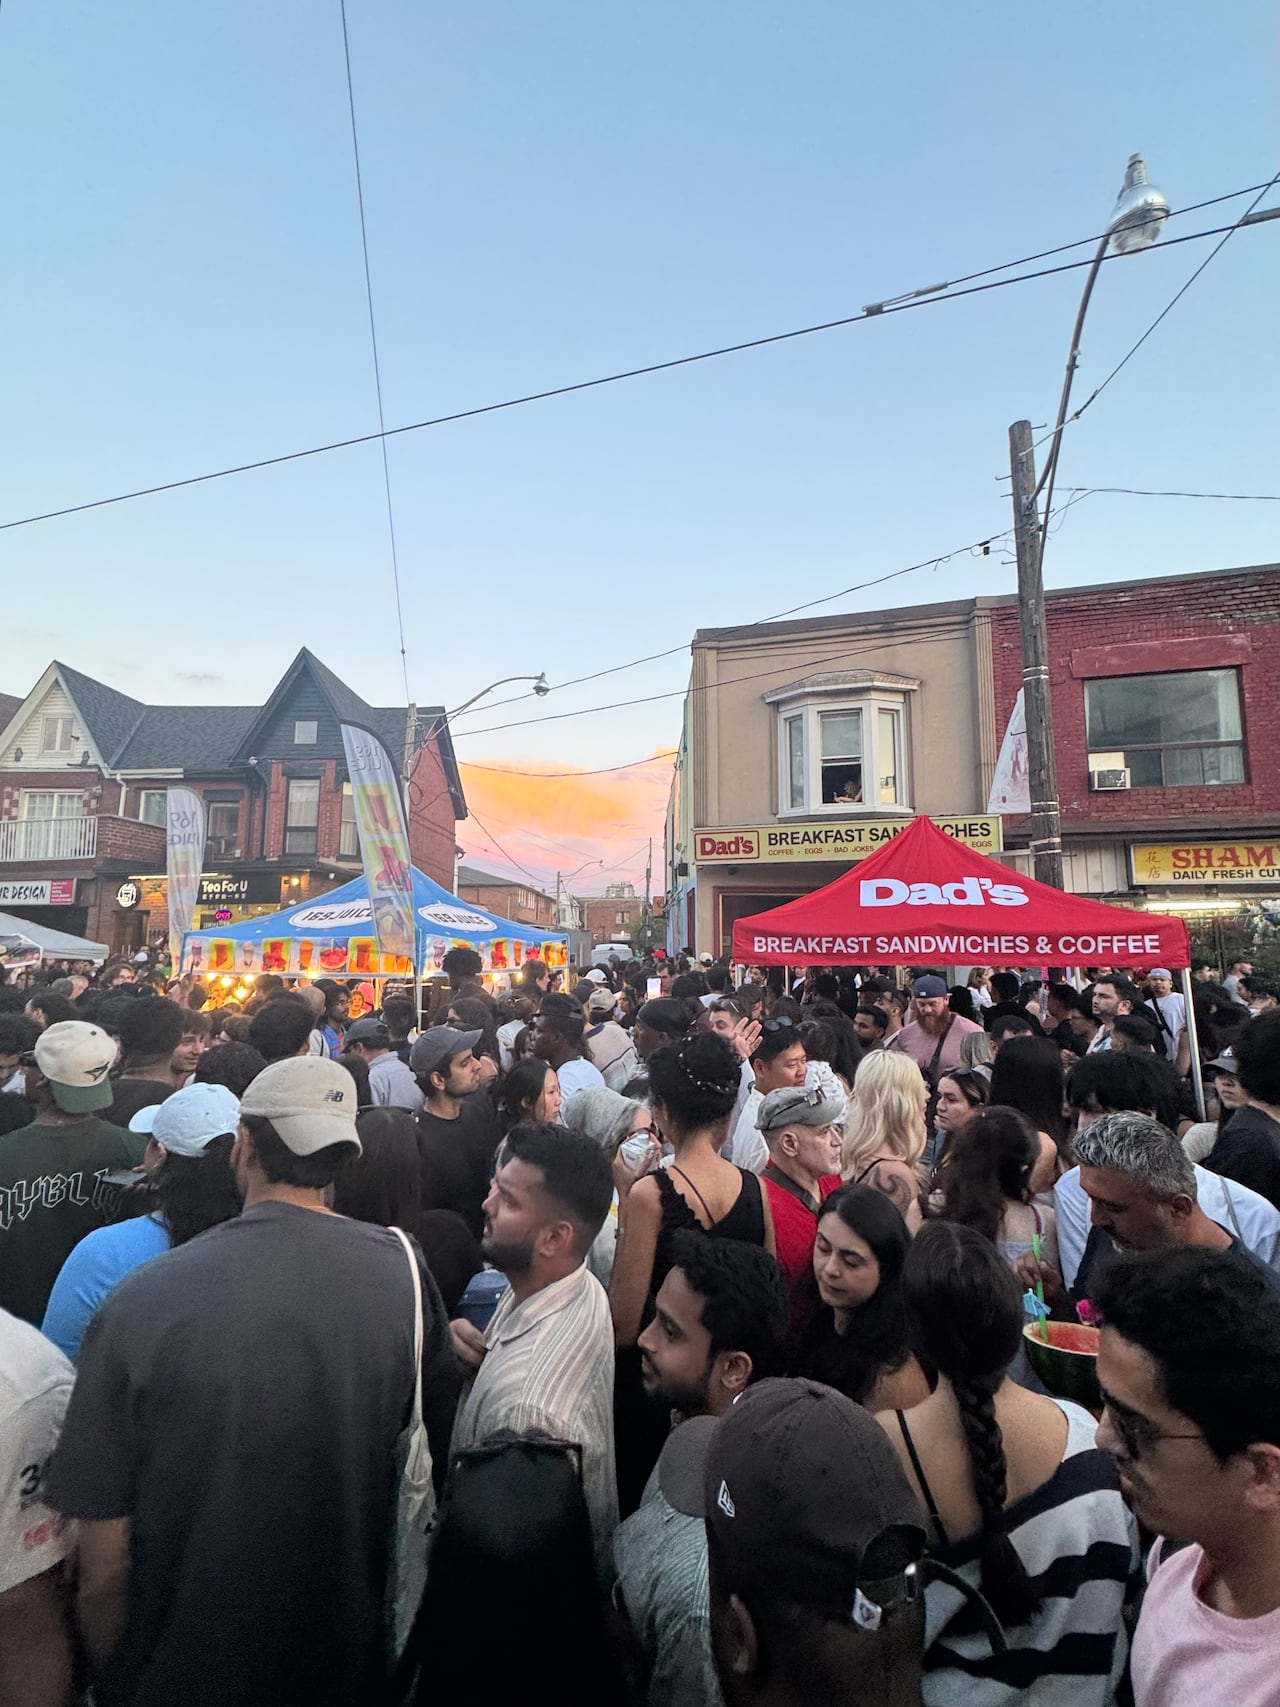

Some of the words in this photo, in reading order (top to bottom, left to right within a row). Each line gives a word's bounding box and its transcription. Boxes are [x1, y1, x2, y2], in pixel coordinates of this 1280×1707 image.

[768, 828, 865, 846] BREAKFAST
[869, 822, 991, 841] SANCHES
[700, 836, 754, 856] Dad's
[851, 845, 874, 853] JOKES
[971, 840, 992, 848] EGGS
[1171, 845, 1280, 869] SHAM
[1173, 870, 1207, 880] DAILY
[1213, 869, 1253, 879] FRESH
[11, 885, 47, 900] DESIGN
[202, 881, 220, 892] Tea
[222, 880, 239, 892] For
[240, 880, 248, 892] U
[860, 877, 1029, 906] Dad's
[754, 936, 871, 953] BREAKFAST
[876, 936, 1029, 953] SANDWICHES
[1035, 936, 1052, 953] &
[1058, 935, 1160, 953] COFFEE
